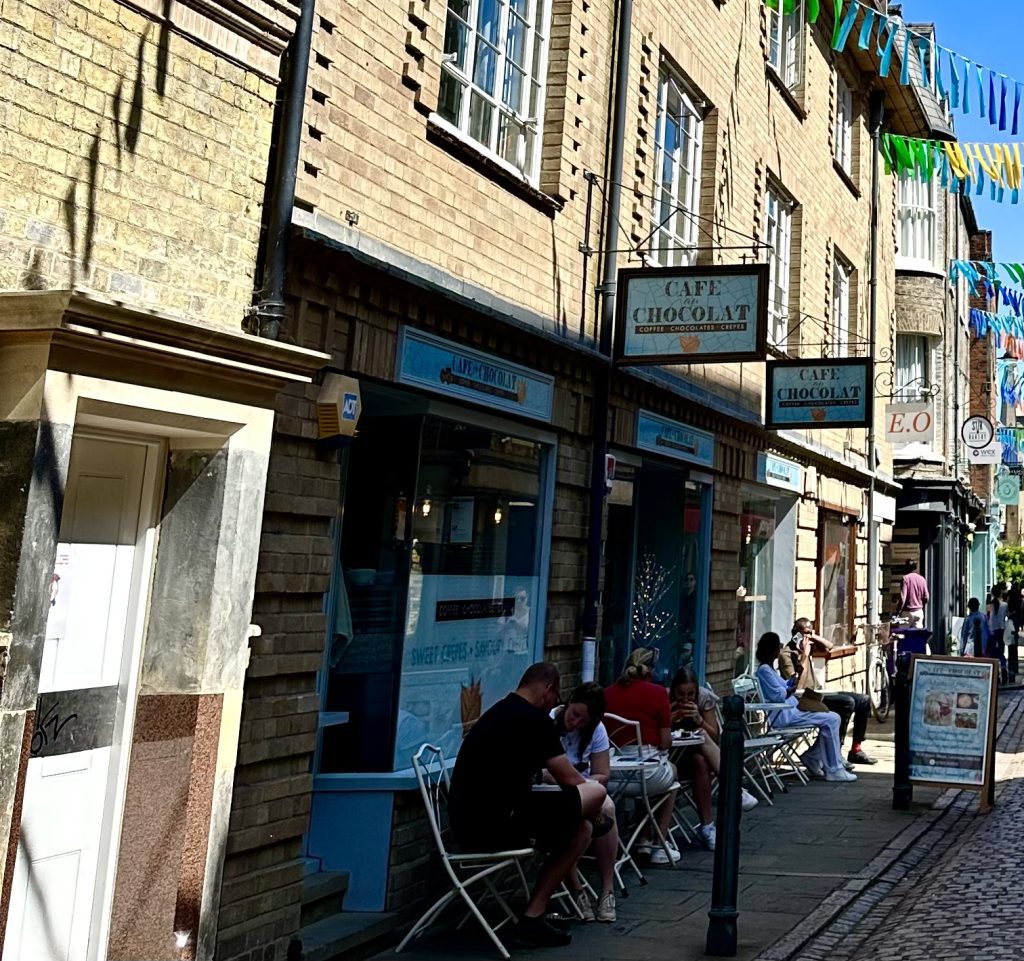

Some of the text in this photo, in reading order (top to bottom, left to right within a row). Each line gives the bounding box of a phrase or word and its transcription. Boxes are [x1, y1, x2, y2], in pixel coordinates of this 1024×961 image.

[665, 280, 722, 296] CAFE
[633, 304, 751, 323] CHOCOLAT
[670, 324, 714, 332] CHOCOLATES
[800, 368, 840, 380] CAFE
[777, 386, 861, 400] CHOCOLAT
[343, 399, 357, 415] ADT
